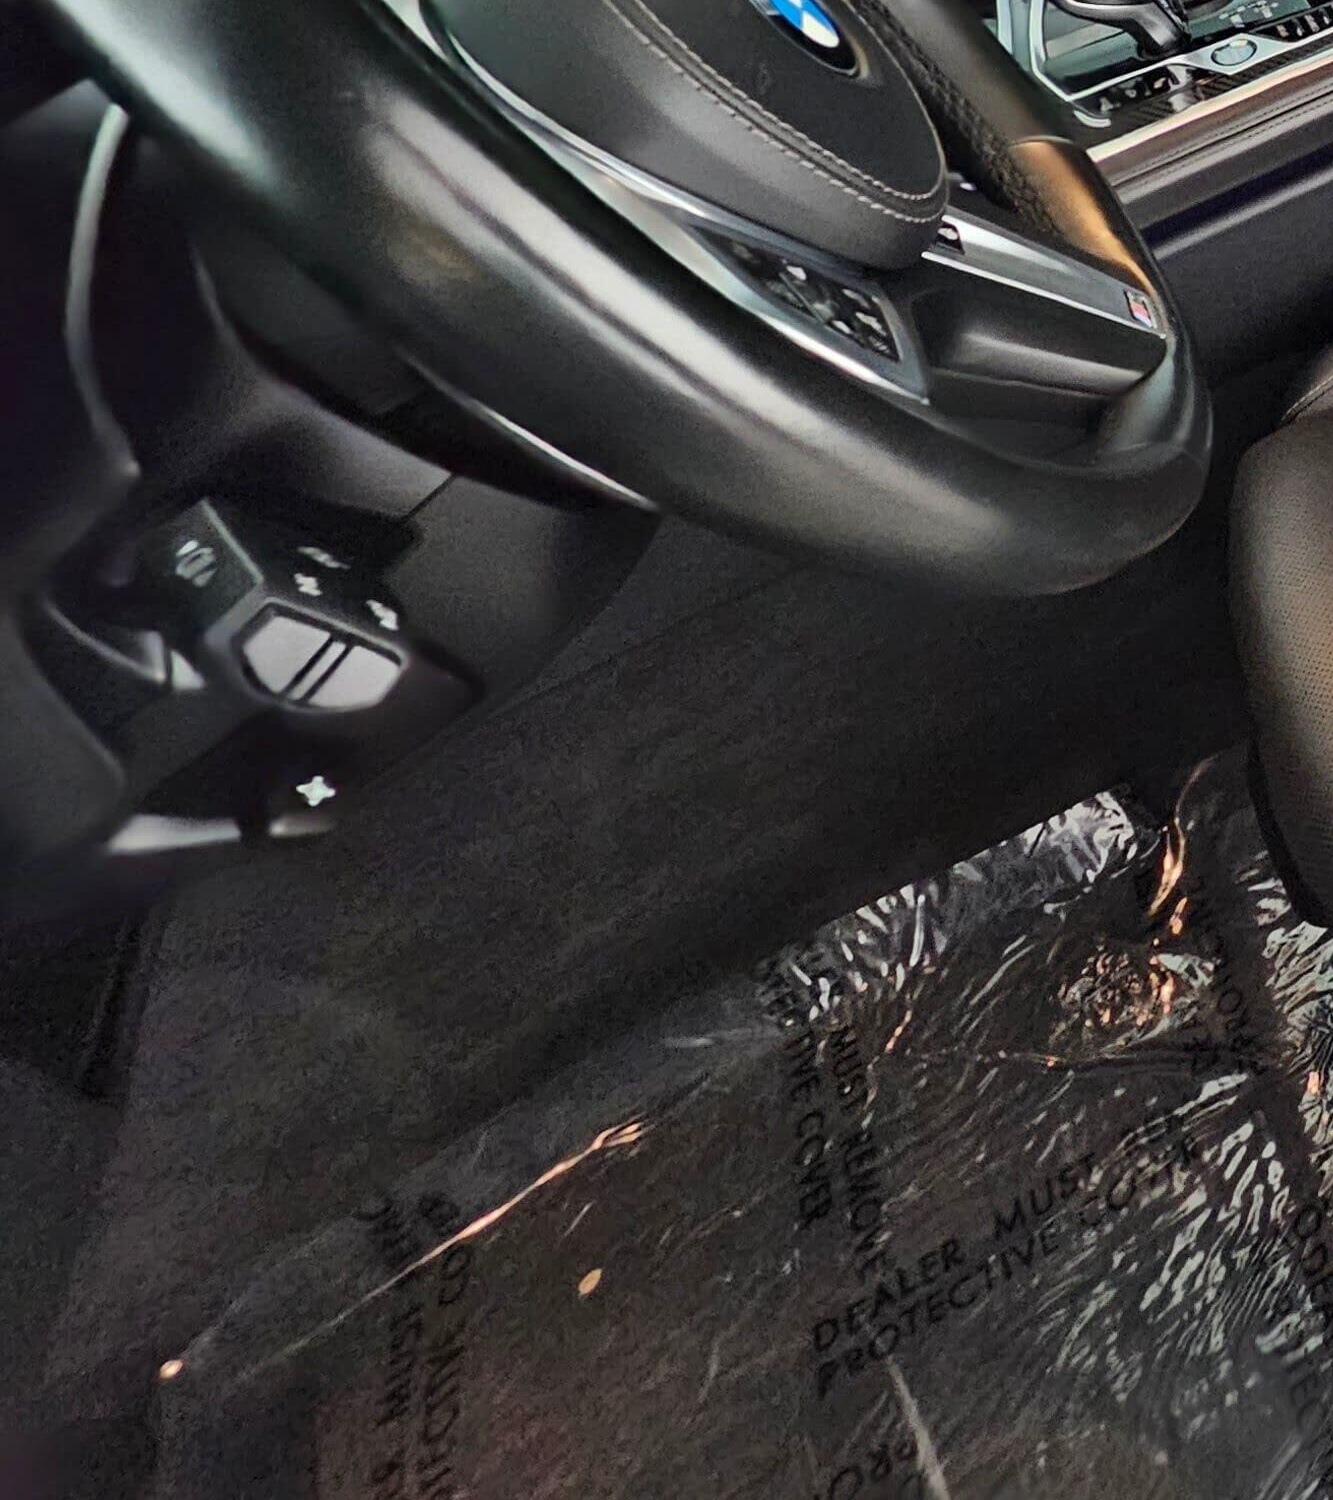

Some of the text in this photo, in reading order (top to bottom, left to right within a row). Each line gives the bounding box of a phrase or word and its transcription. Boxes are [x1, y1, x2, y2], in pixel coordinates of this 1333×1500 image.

[812, 1151, 1099, 1352] DEALER MUST
[816, 1224, 1060, 1401] PROTECTIVE
